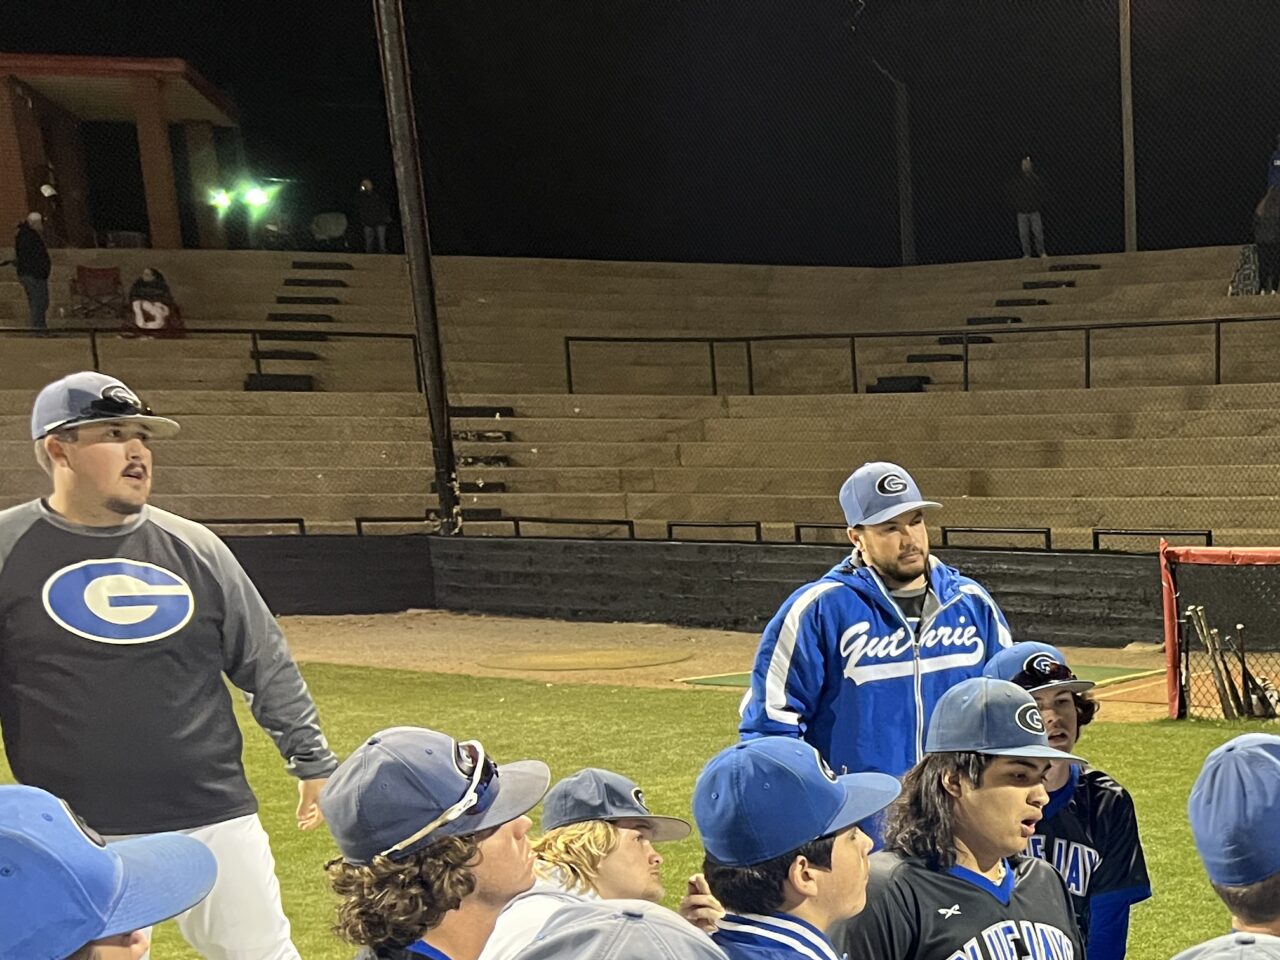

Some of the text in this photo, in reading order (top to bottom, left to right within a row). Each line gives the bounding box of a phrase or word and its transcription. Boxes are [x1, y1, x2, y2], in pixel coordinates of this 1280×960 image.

[876, 473, 908, 497] G
[42, 558, 195, 645] G
[840, 616, 984, 672] Guthrie
